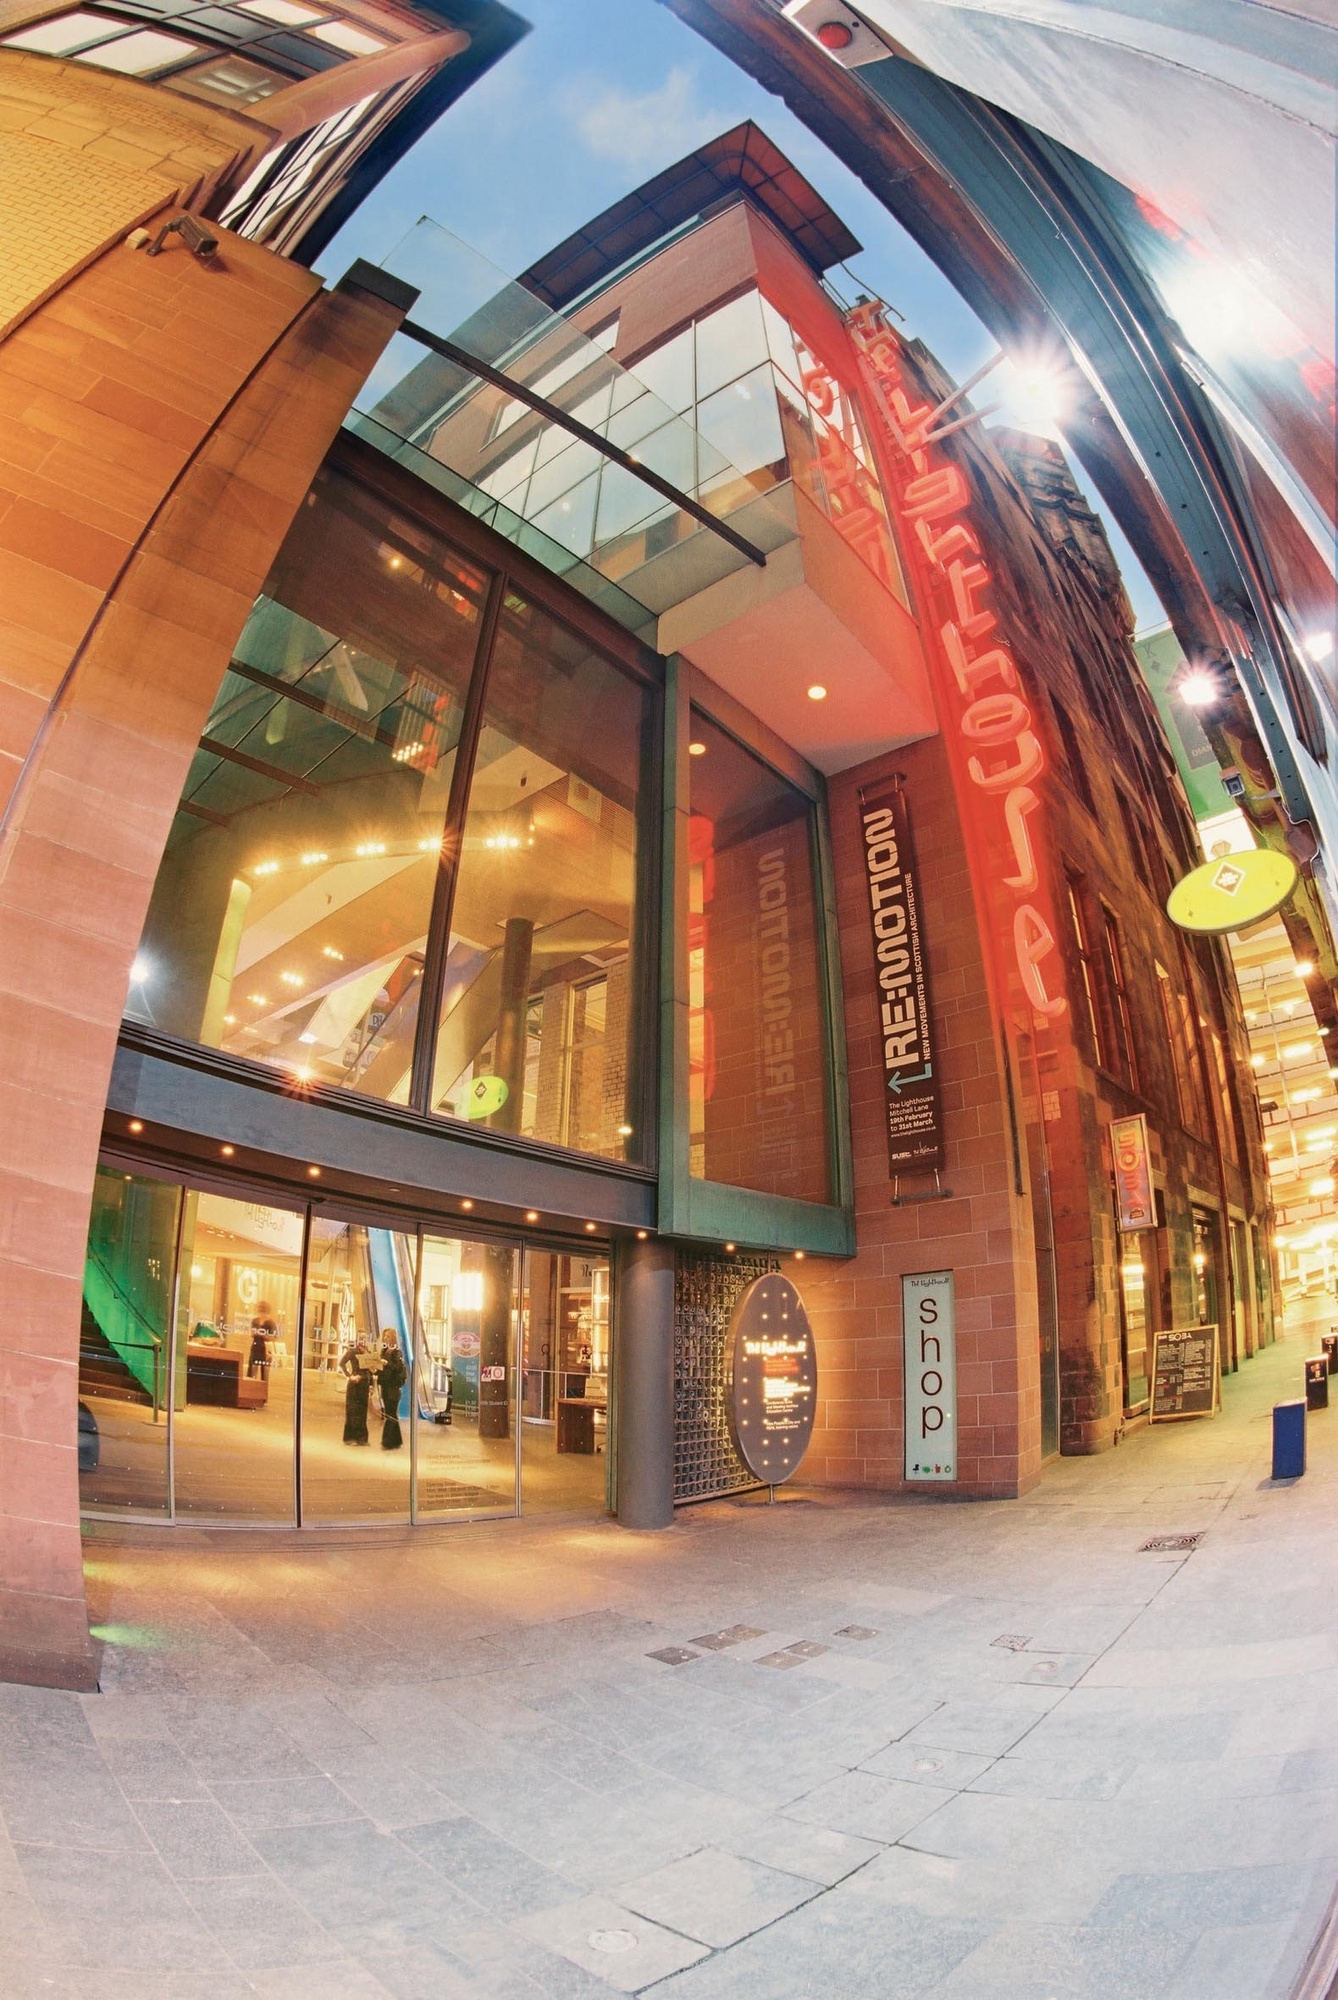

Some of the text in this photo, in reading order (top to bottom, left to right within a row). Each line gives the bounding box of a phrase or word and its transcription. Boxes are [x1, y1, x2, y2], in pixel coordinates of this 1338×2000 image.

[850, 299, 902, 383] The
[863, 808, 920, 1069] RE:MOTION
[904, 873, 931, 1060] NEW MOVEMENTS IN SCOTTISH ARCHITECTURE
[889, 1104, 928, 1117] Mitchell Lane
[890, 1111, 933, 1125] 19th February
[898, 1122, 913, 1131] 31st
[913, 1118, 934, 1128] March
[901, 1096, 934, 1107] Lighthouse
[919, 1298, 944, 1439] shop
